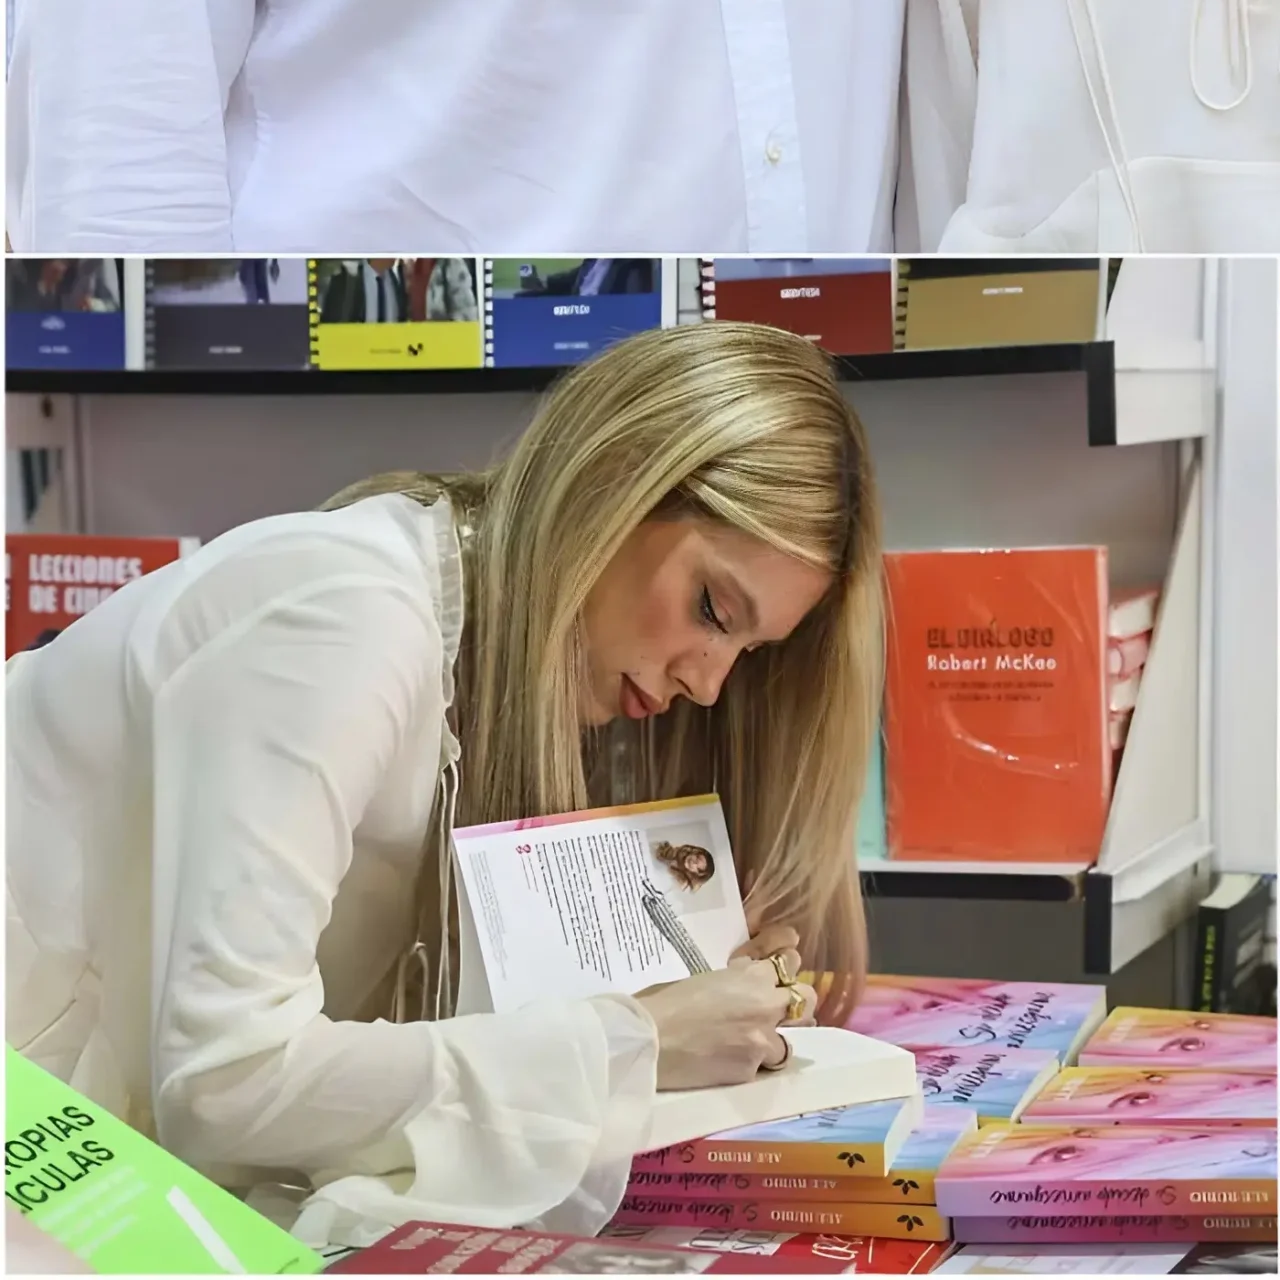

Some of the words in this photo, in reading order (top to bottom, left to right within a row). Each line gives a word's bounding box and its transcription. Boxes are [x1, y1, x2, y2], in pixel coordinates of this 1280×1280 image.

[28, 554, 143, 584] LECCIONES
[28, 585, 58, 613] DE
[927, 627, 954, 648] EL
[927, 653, 987, 671] Robert
[995, 653, 1057, 671] McKee
[1096, 1186, 1149, 1210] decido
